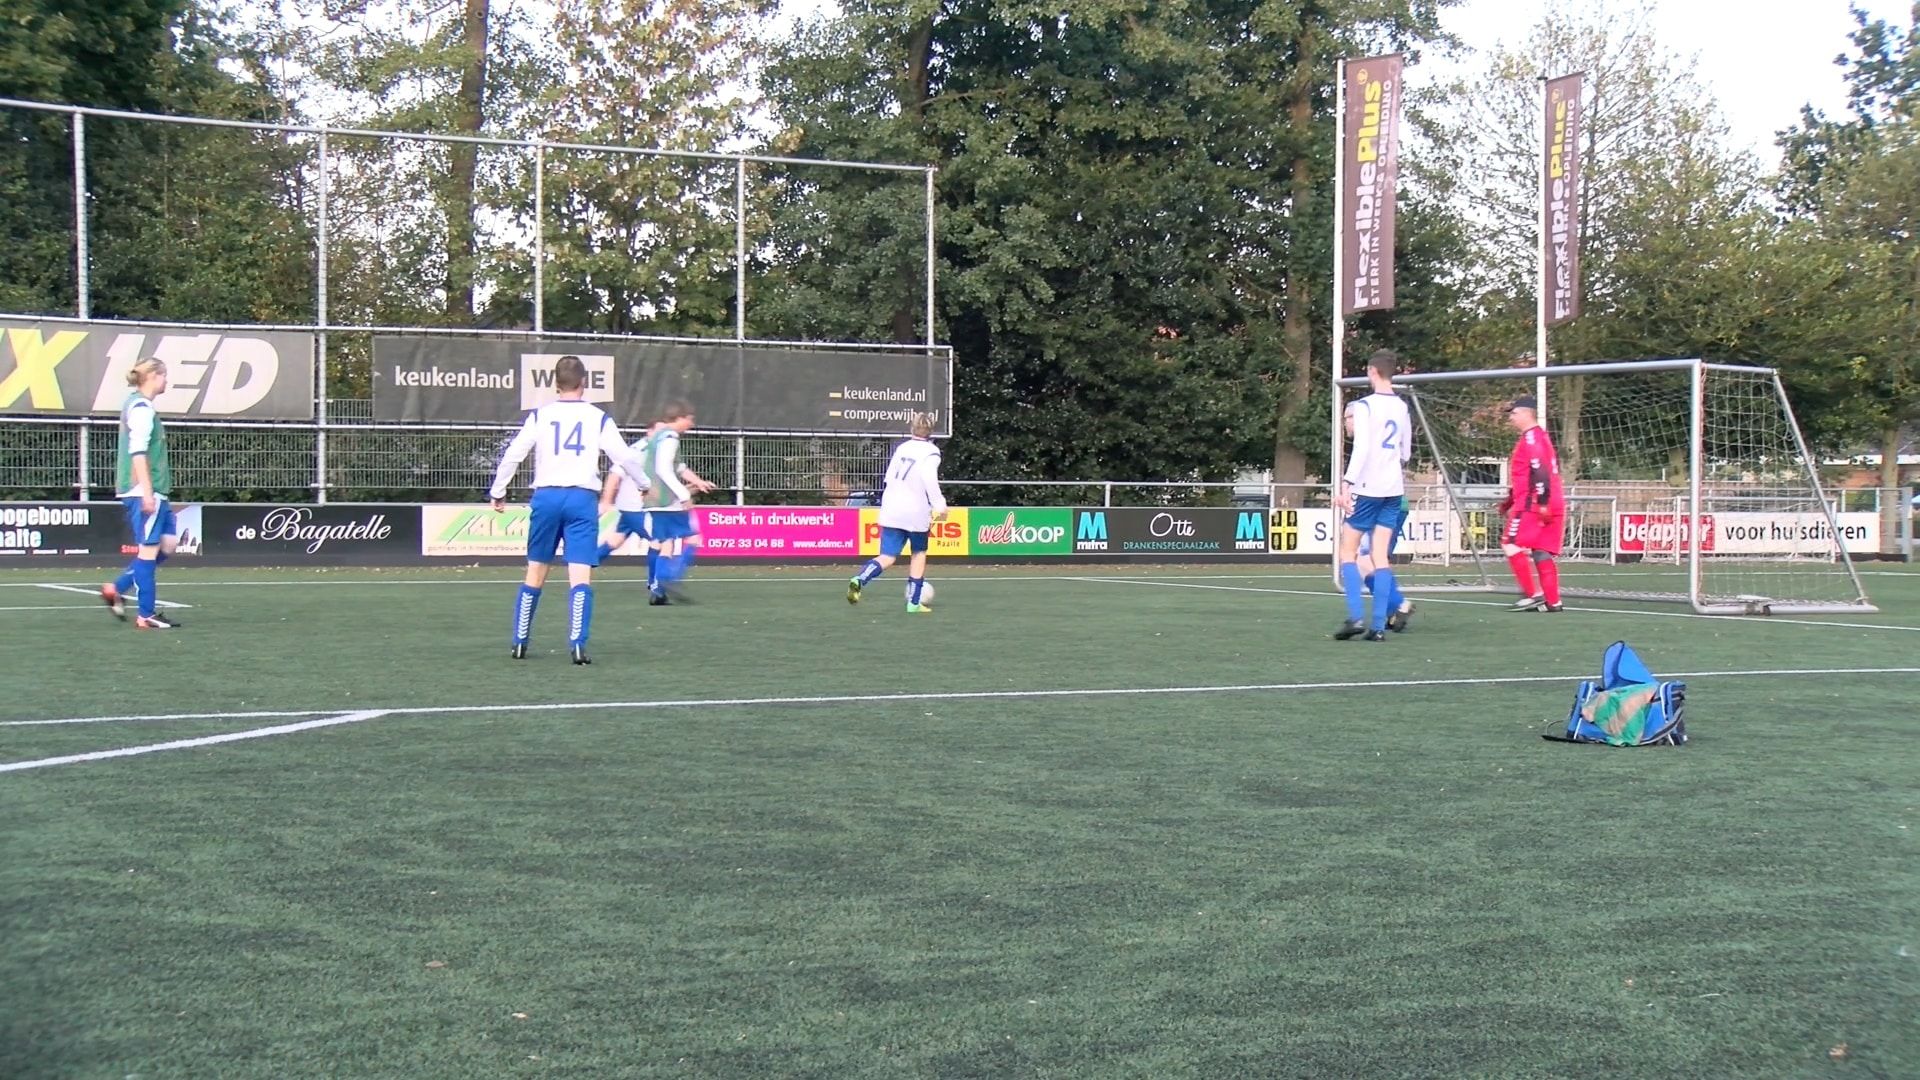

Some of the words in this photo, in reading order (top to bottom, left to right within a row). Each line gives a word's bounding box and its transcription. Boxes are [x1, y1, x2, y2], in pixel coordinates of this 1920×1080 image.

[1353, 80, 1382, 309] FlexiblePlus
[1372, 187, 1384, 233] WERK
[1370, 236, 1380, 253] IN
[1370, 257, 1381, 305] STERK
[0, 327, 90, 409] X
[394, 366, 515, 389] keukenland
[844, 386, 927, 402] keukenland.nl
[550, 420, 586, 457] 14
[1381, 419, 1398, 449] 2
[708, 511, 748, 525] Sterk
[751, 512, 763, 525] in
[768, 512, 835, 526] drukwerk!
[1149, 512, 1196, 537] Otte
[235, 525, 256, 540] de
[261, 507, 392, 554] Bagatelle
[1725, 523, 1767, 541] voor
[708, 538, 736, 548] 0572
[738, 538, 752, 548] 33
[754, 538, 768, 548] 04
[793, 539, 854, 549] www.ddmc.nl
[1076, 541, 1108, 551] mitra
[1123, 541, 1220, 550] DRANKENSPECIAALZAAK
[1234, 541, 1265, 550] mitra
